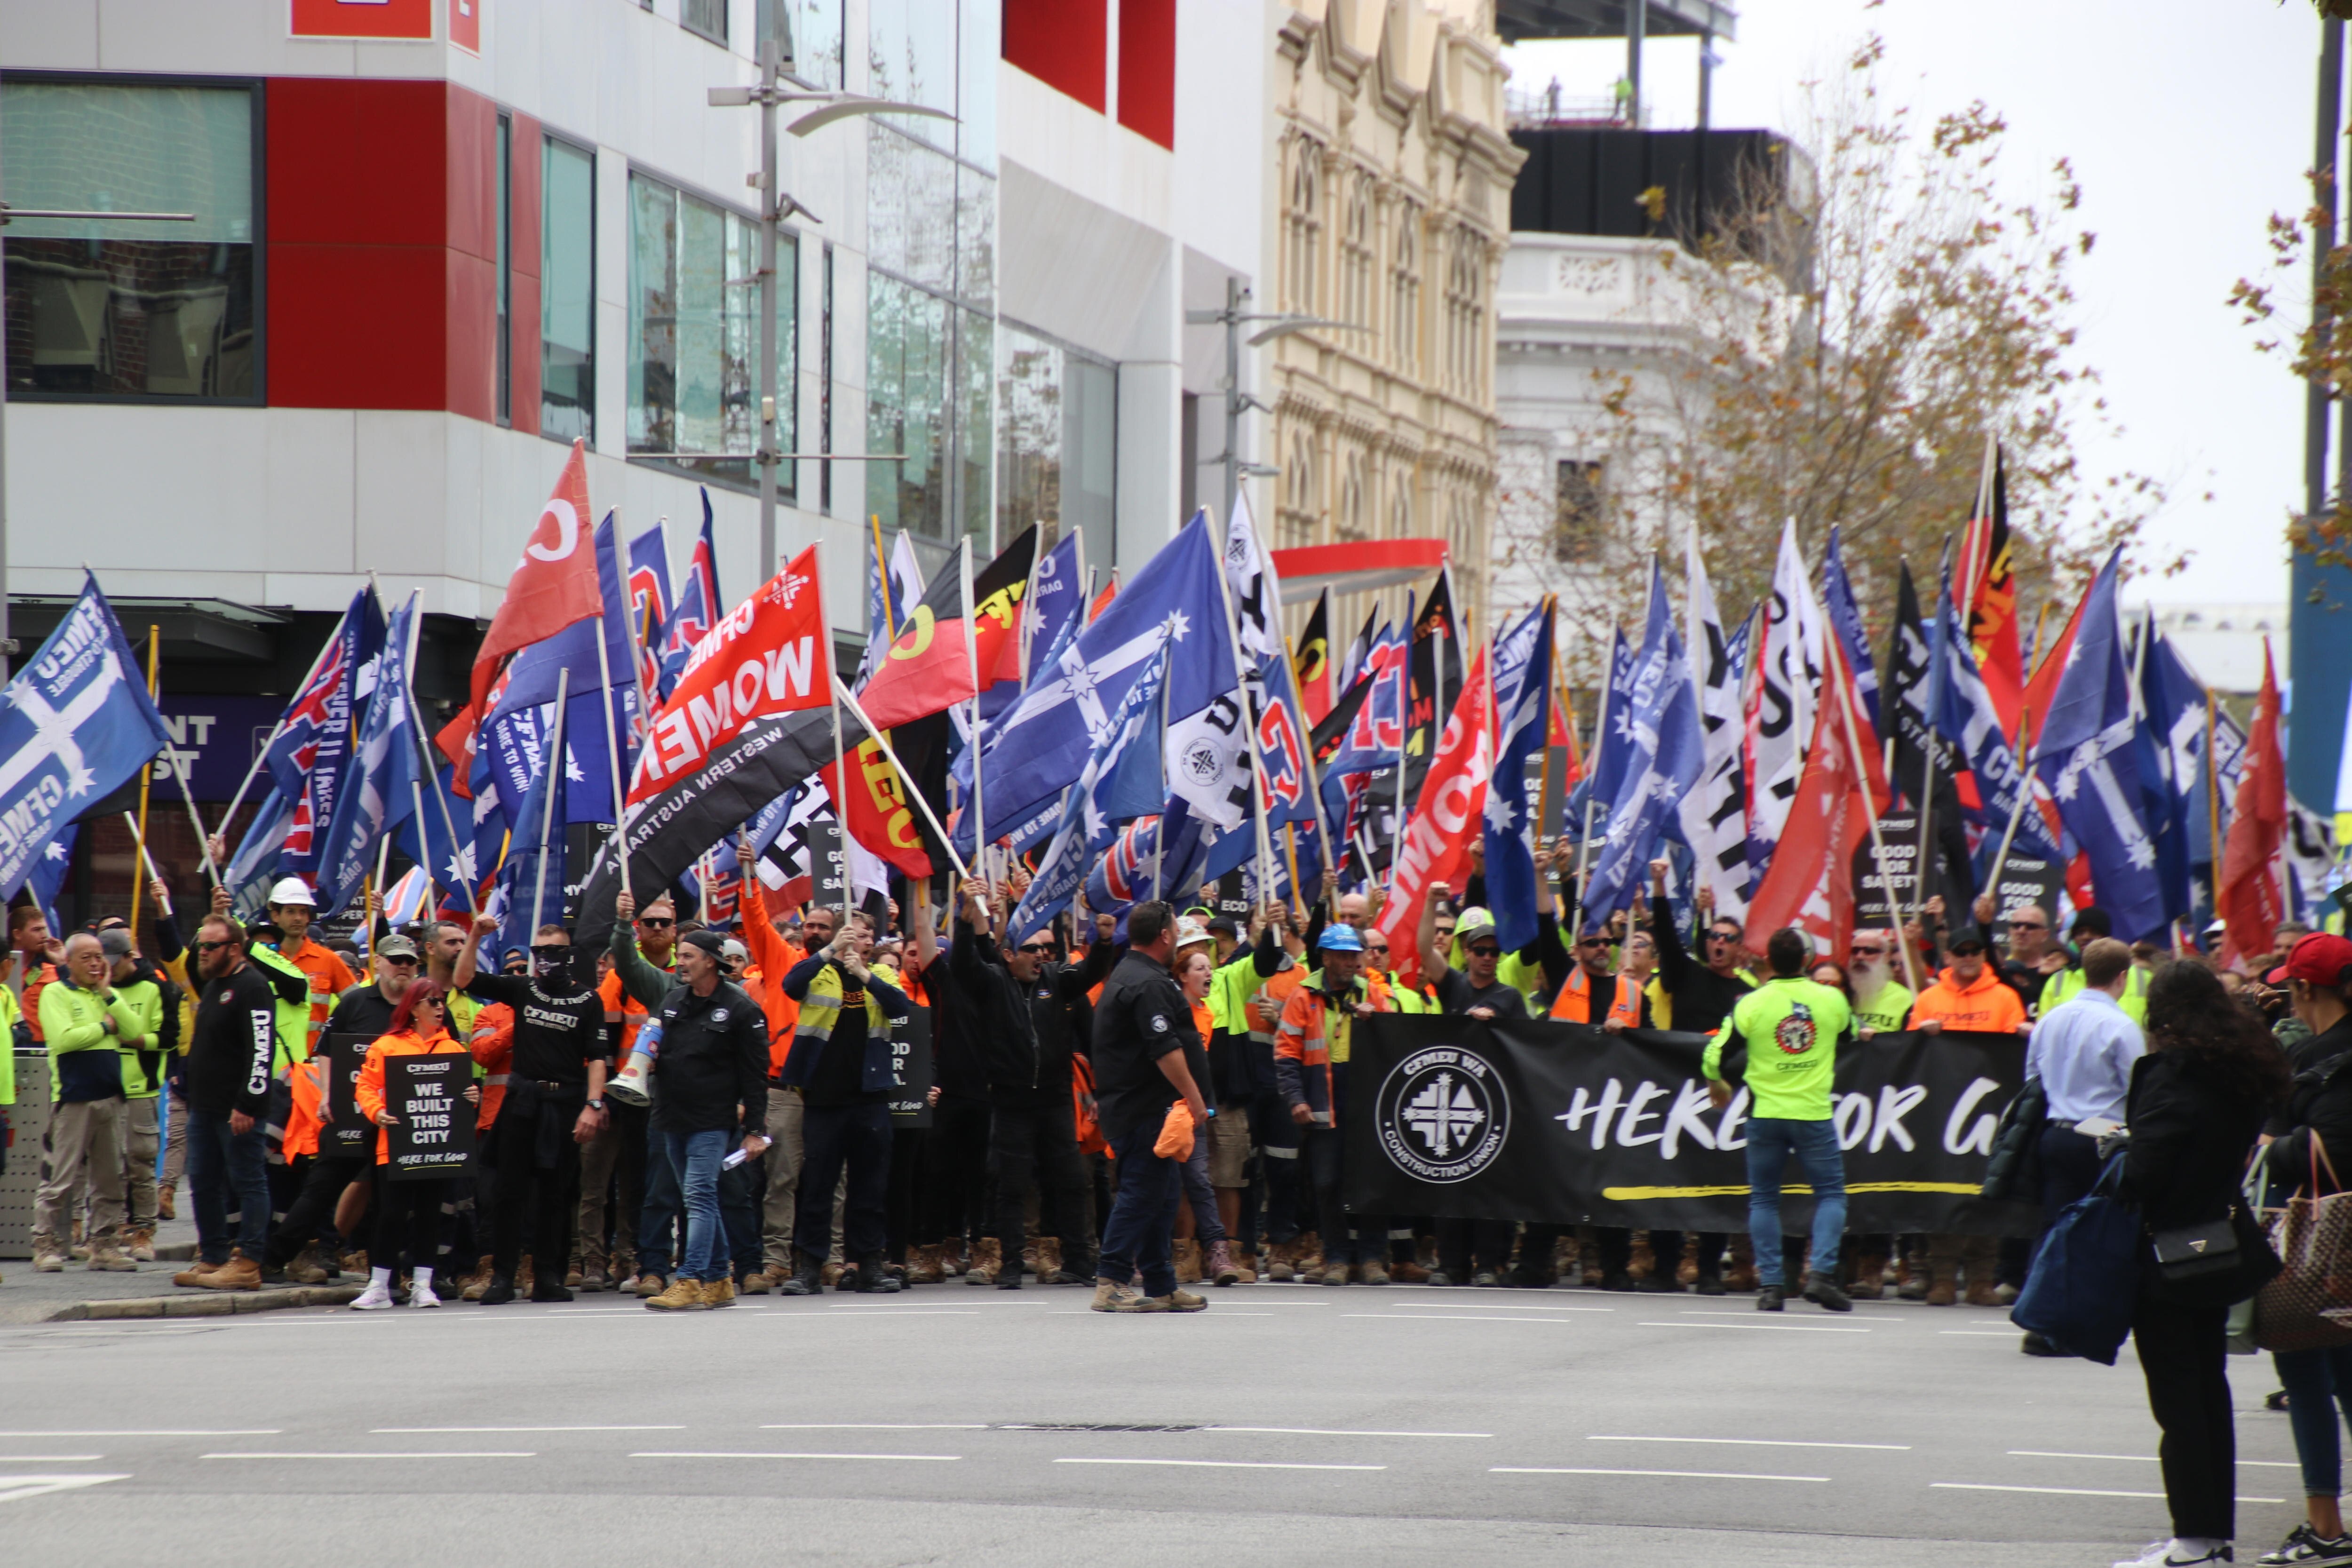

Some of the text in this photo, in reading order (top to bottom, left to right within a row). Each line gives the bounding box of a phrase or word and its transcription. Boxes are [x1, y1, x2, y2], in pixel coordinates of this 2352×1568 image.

[495, 719, 514, 750] DARE
[503, 748, 520, 764] TO
[523, 1004, 579, 1028] CFMEU
[247, 1010, 271, 1095] CFMEU
[405, 1062, 451, 1073] CFMEU
[1404, 1051, 1487, 1078] CFMEU WA
[414, 1083, 444, 1097] WE
[405, 1098, 454, 1113] BUILT
[409, 1114, 450, 1128] THIS
[1831, 1084, 1928, 1154] OR
[412, 1130, 450, 1145] CITY
[397, 1154, 423, 1165] HERE
[424, 1154, 444, 1163] FOR
[1384, 1130, 1501, 1178] CONSTRUCTION UNION
